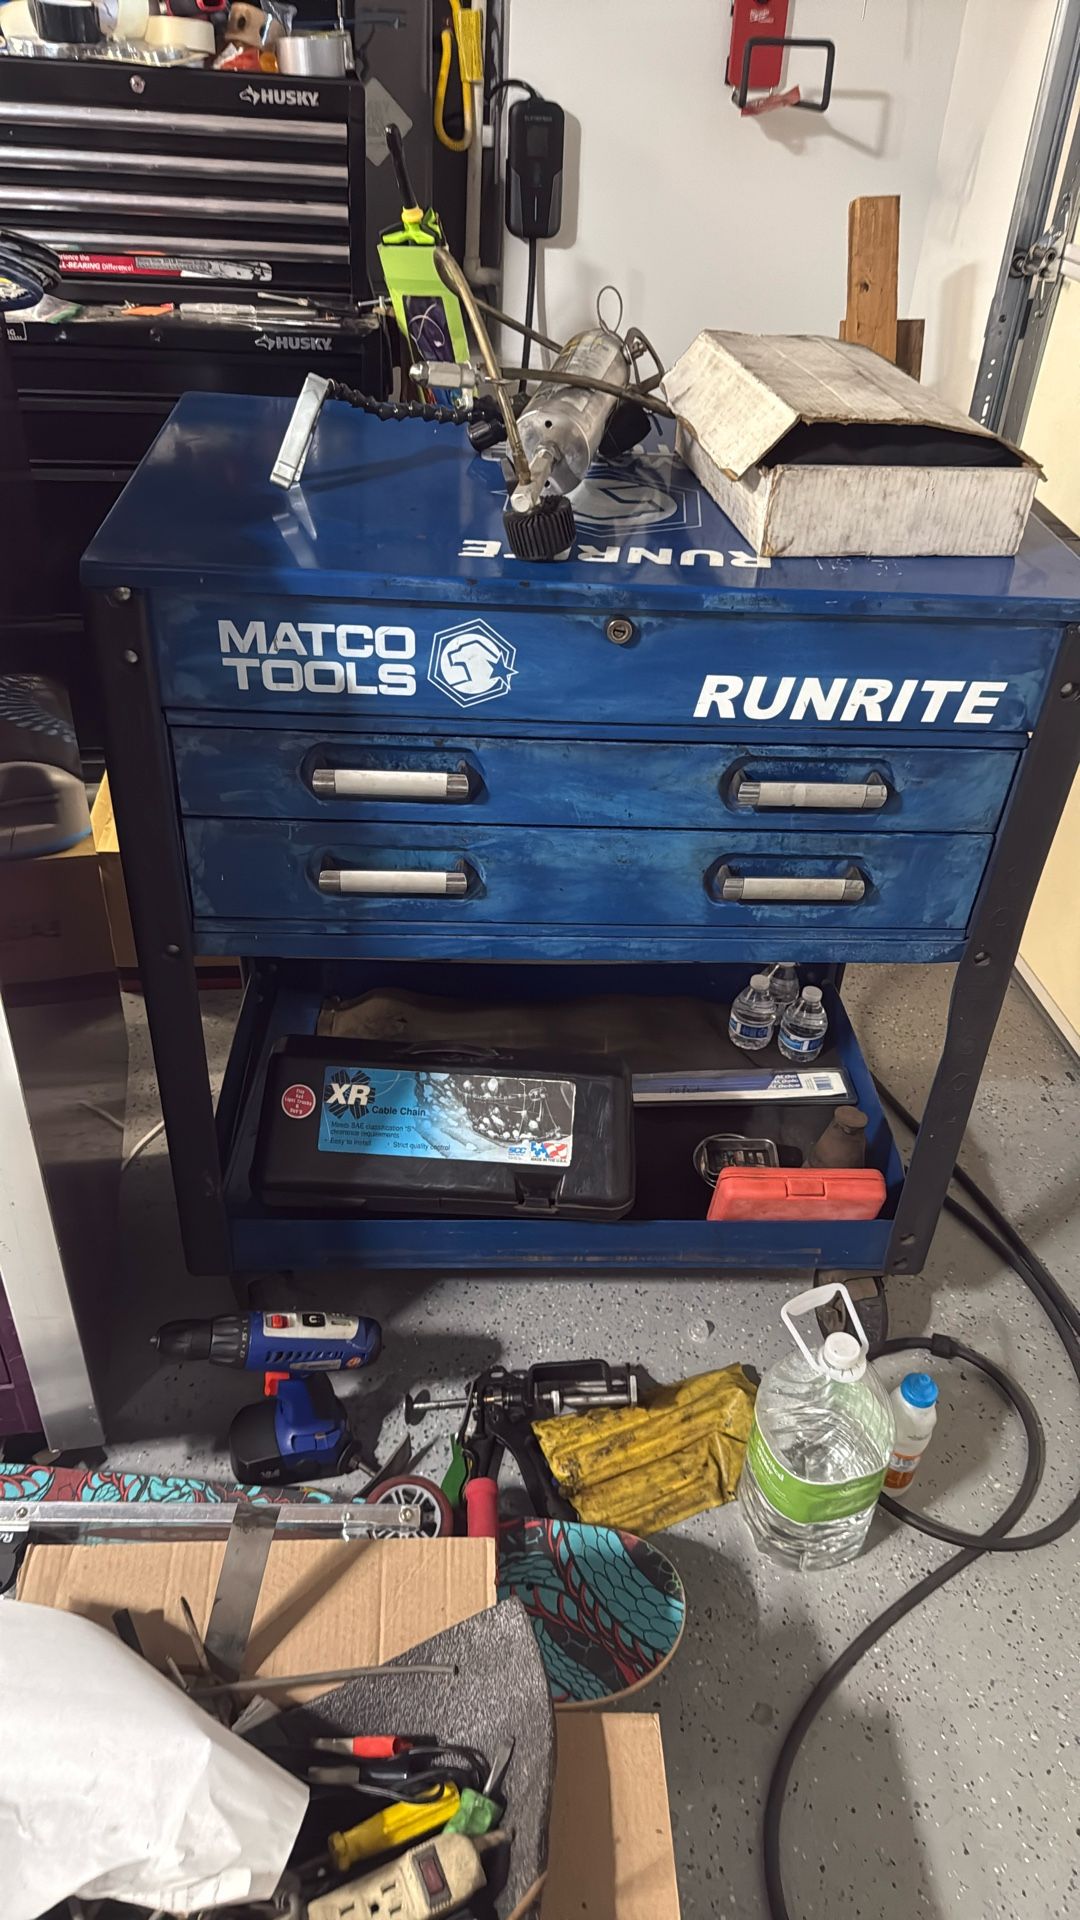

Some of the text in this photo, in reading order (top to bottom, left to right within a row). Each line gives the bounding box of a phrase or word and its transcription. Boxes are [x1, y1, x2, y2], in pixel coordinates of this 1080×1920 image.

[261, 88, 318, 107] HUSKY
[276, 336, 332, 351] HUSKY
[458, 539, 772, 568] RUNRE
[217, 619, 416, 659] MATCO
[222, 658, 417, 696] TOOLS
[692, 674, 1009, 724] RUNRITE
[326, 1082, 371, 1106] XR
[371, 1105, 426, 1117] Cable Chain
[351, 1122, 364, 1130] SAE
[365, 1123, 404, 1132] classification
[361, 1131, 400, 1139] requirements
[330, 1137, 345, 1146] Easy
[393, 1141, 408, 1149] Strict
[409, 1142, 429, 1151] quality
